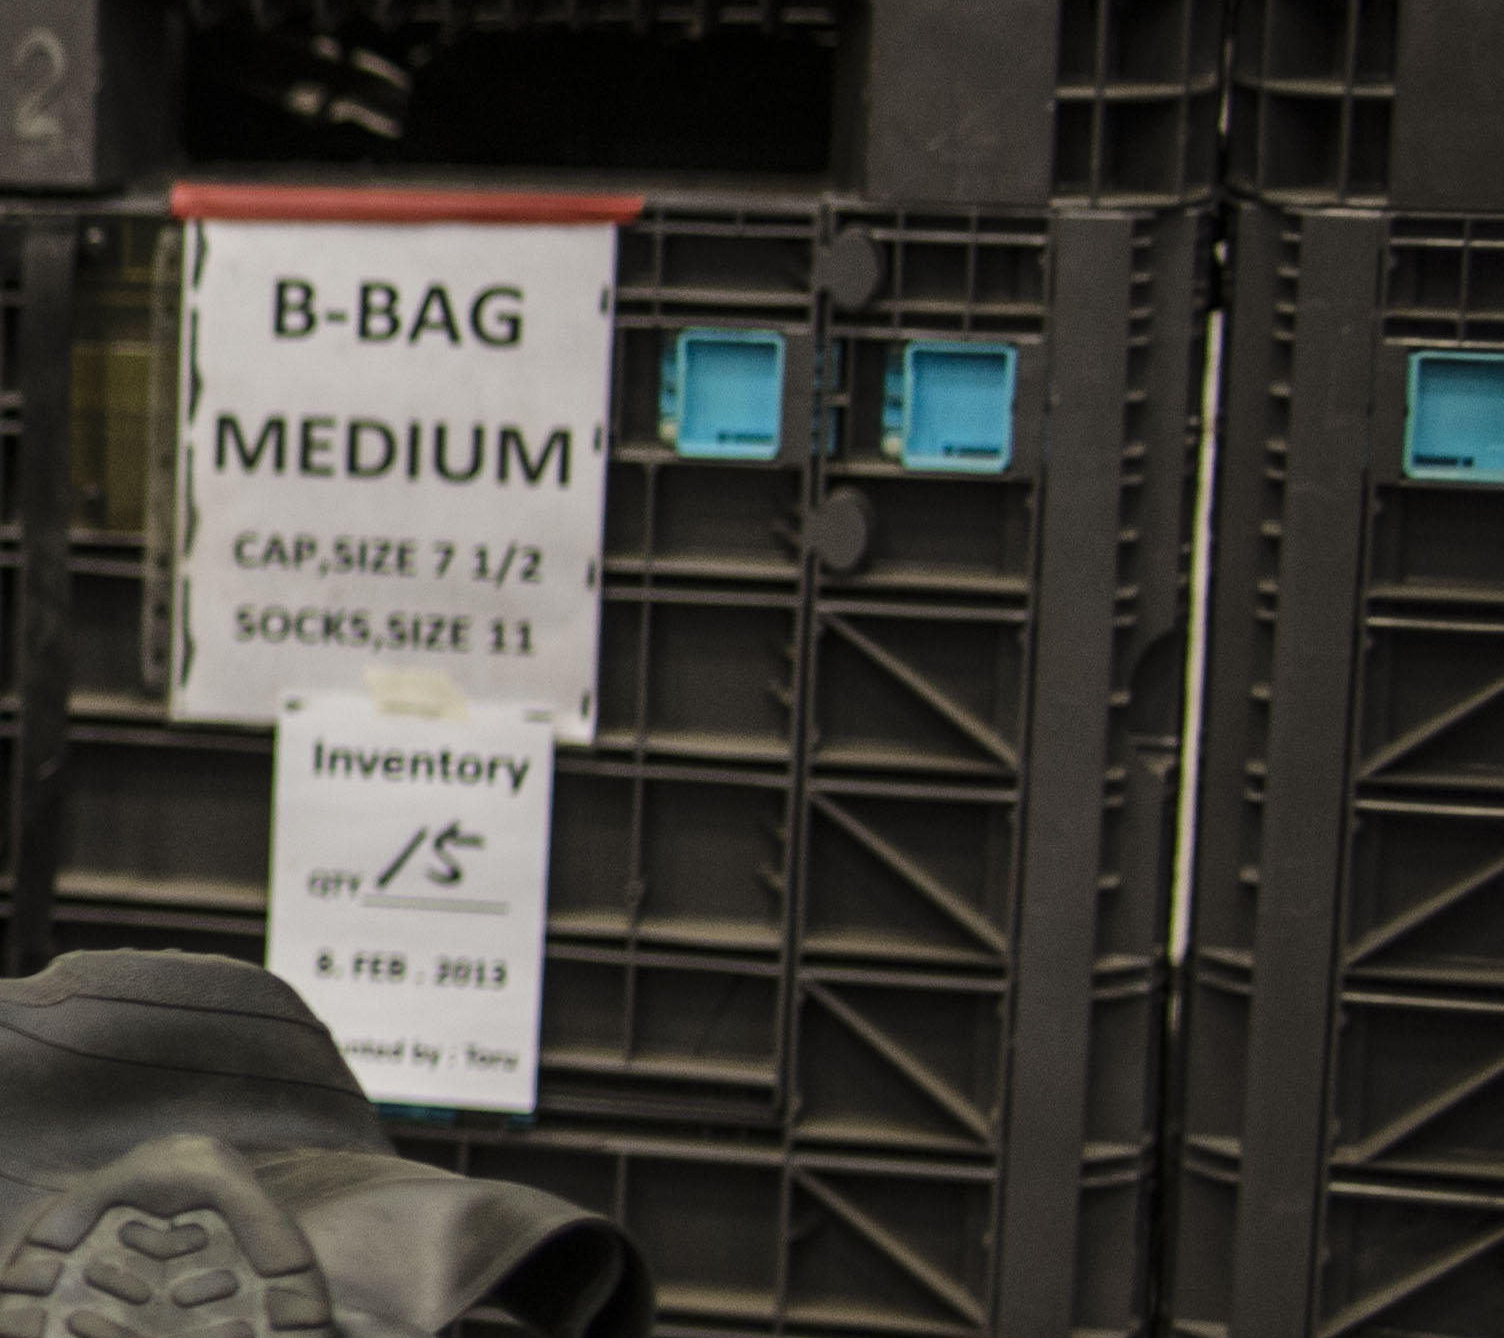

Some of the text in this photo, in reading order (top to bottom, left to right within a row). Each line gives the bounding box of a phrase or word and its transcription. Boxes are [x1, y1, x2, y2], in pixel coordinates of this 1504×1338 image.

[12, 25, 68, 139] 2
[272, 278, 523, 349] B-BAG
[214, 413, 574, 489] MEDIUM
[232, 534, 543, 588] CAP,SIZE 7 1/2
[235, 607, 533, 656] SOCKS,SIZE 11
[312, 741, 530, 794] Inventory
[306, 870, 362, 898] QTY
[376, 822, 484, 889] 15
